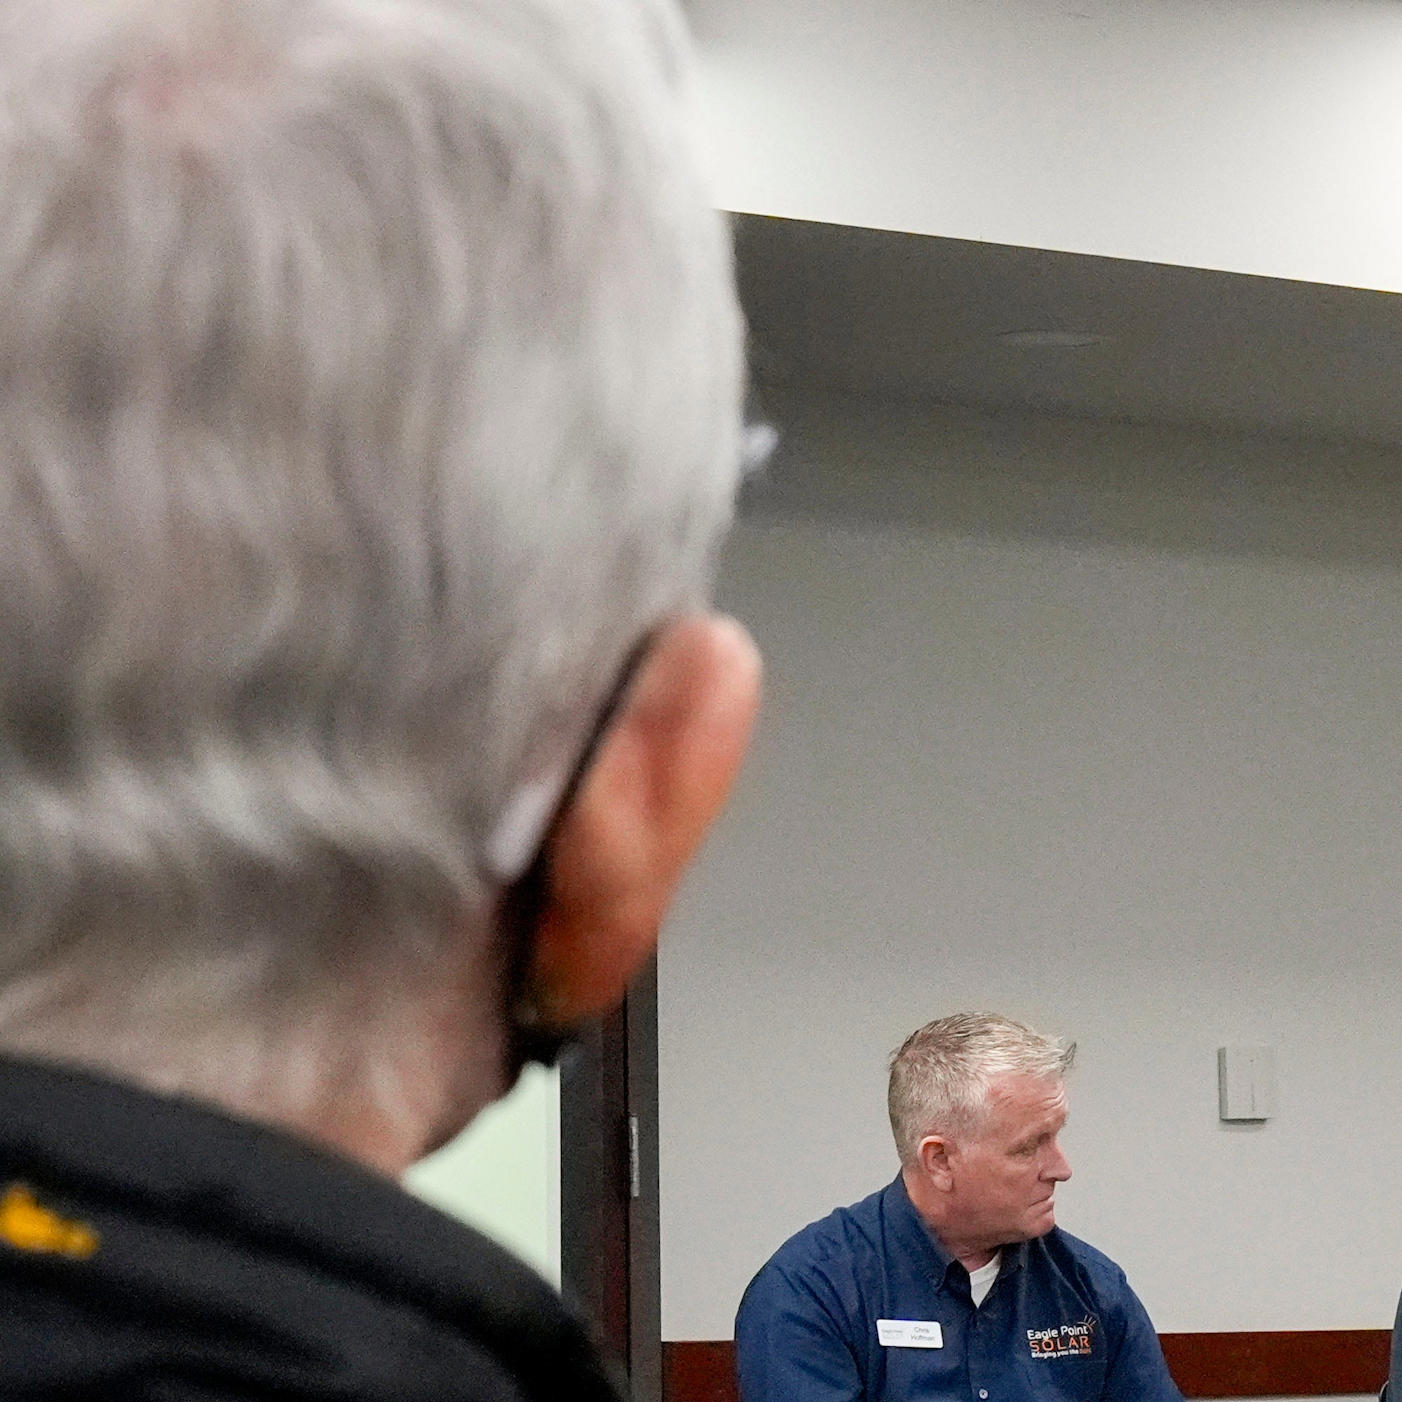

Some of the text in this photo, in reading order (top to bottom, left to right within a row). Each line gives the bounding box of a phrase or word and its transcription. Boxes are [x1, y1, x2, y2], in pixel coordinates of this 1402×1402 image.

[1027, 1325, 1089, 1341] Eagle Point
[1029, 1336, 1090, 1352] SOLAR
